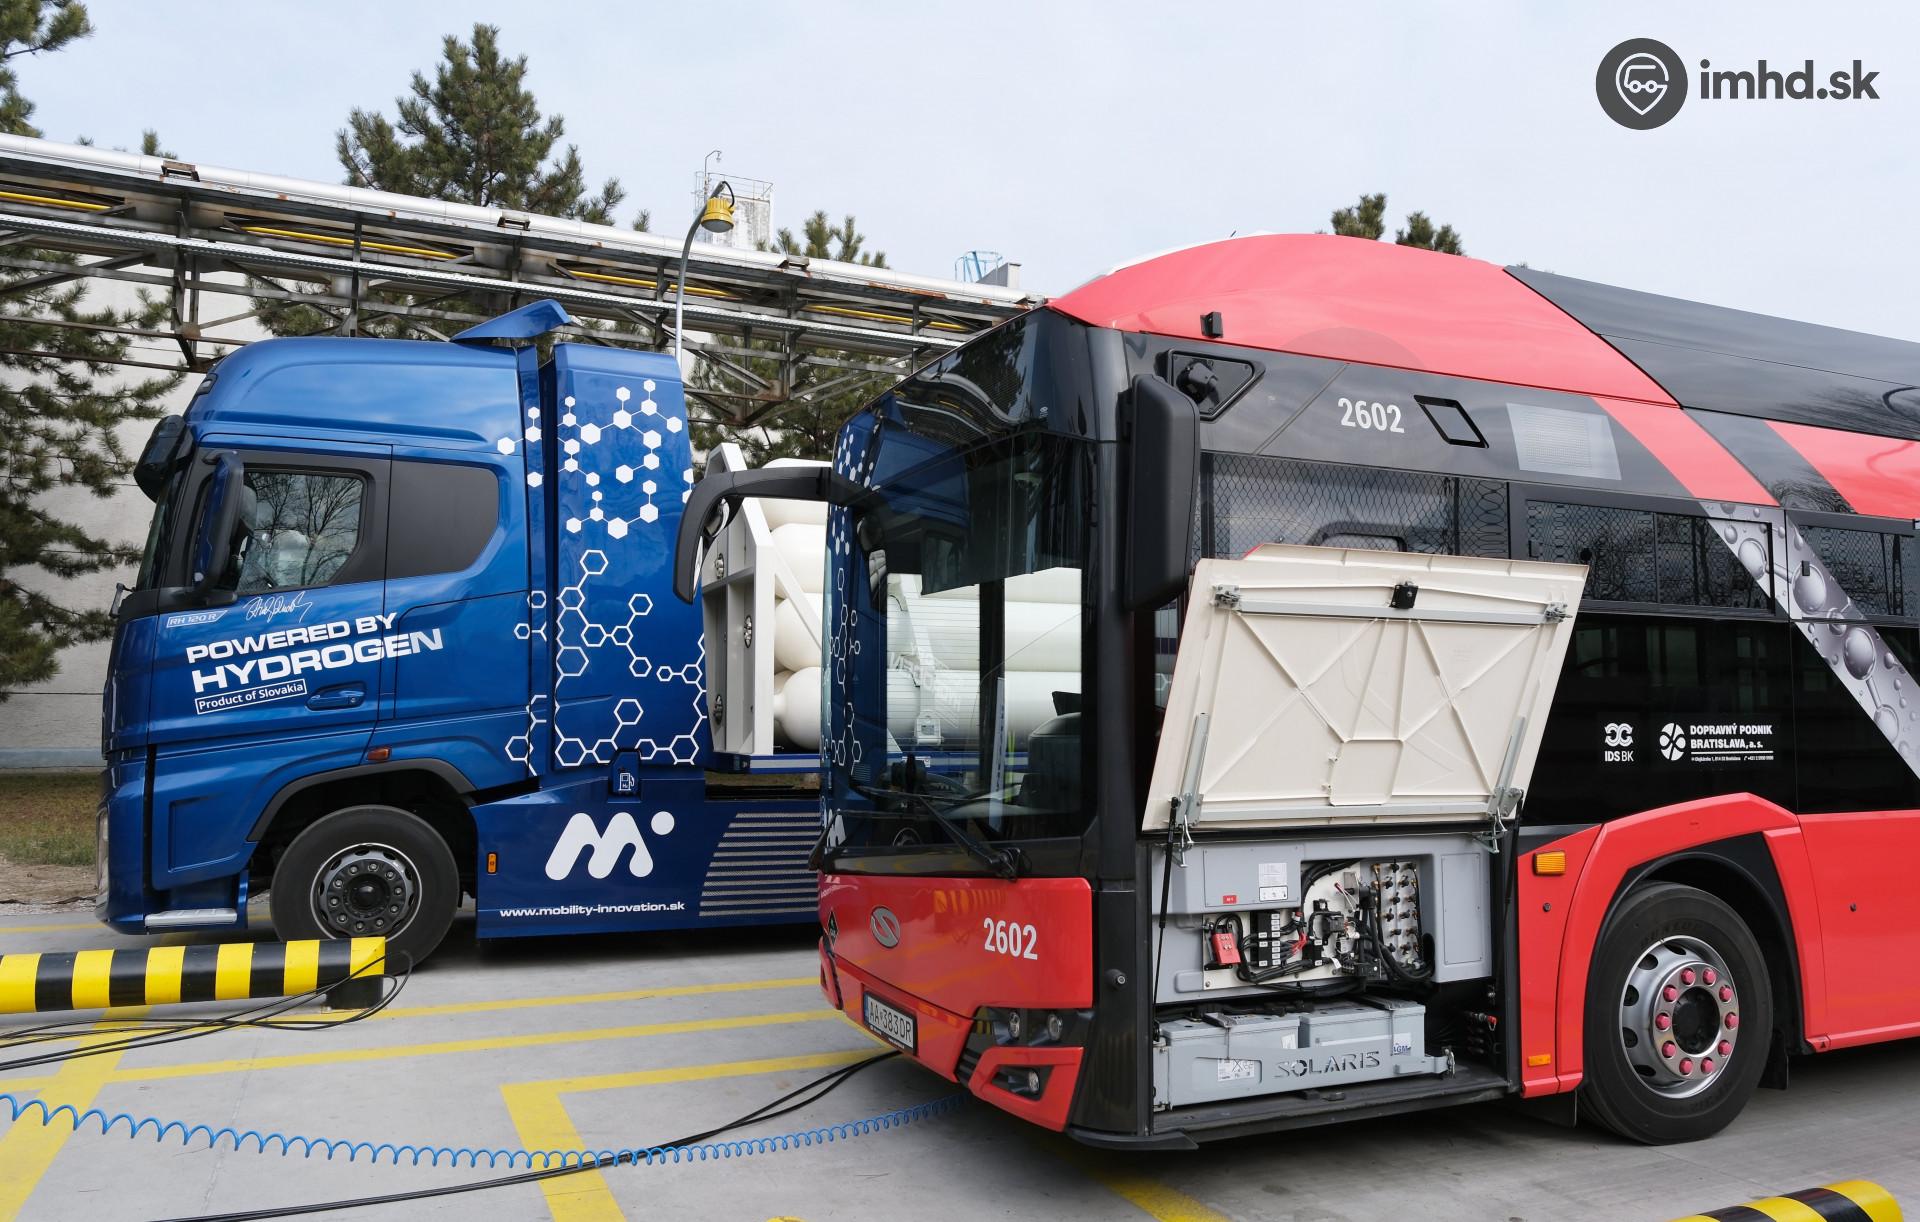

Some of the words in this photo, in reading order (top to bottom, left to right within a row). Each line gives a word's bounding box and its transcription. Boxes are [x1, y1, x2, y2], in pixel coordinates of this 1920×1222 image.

[1337, 397, 1405, 434] 2602
[169, 615, 185, 626] RH
[187, 614, 206, 623] 120
[207, 612, 216, 621] R
[185, 620, 351, 664] POWERED
[355, 611, 398, 636] BY
[191, 628, 445, 693] HYDROGEN
[198, 696, 243, 710] Product
[245, 690, 257, 701] of
[258, 683, 304, 699] Slovakia
[1690, 722, 1738, 735] DOPRAVNÝ
[1739, 725, 1773, 735] PODNIK
[1604, 751, 1620, 762] IDS
[1621, 751, 1634, 762] BK
[499, 901, 685, 918] www.mobility-innovation.sk
[983, 917, 1038, 960] 2602
[1273, 1050, 1380, 1078] SOLARIS
